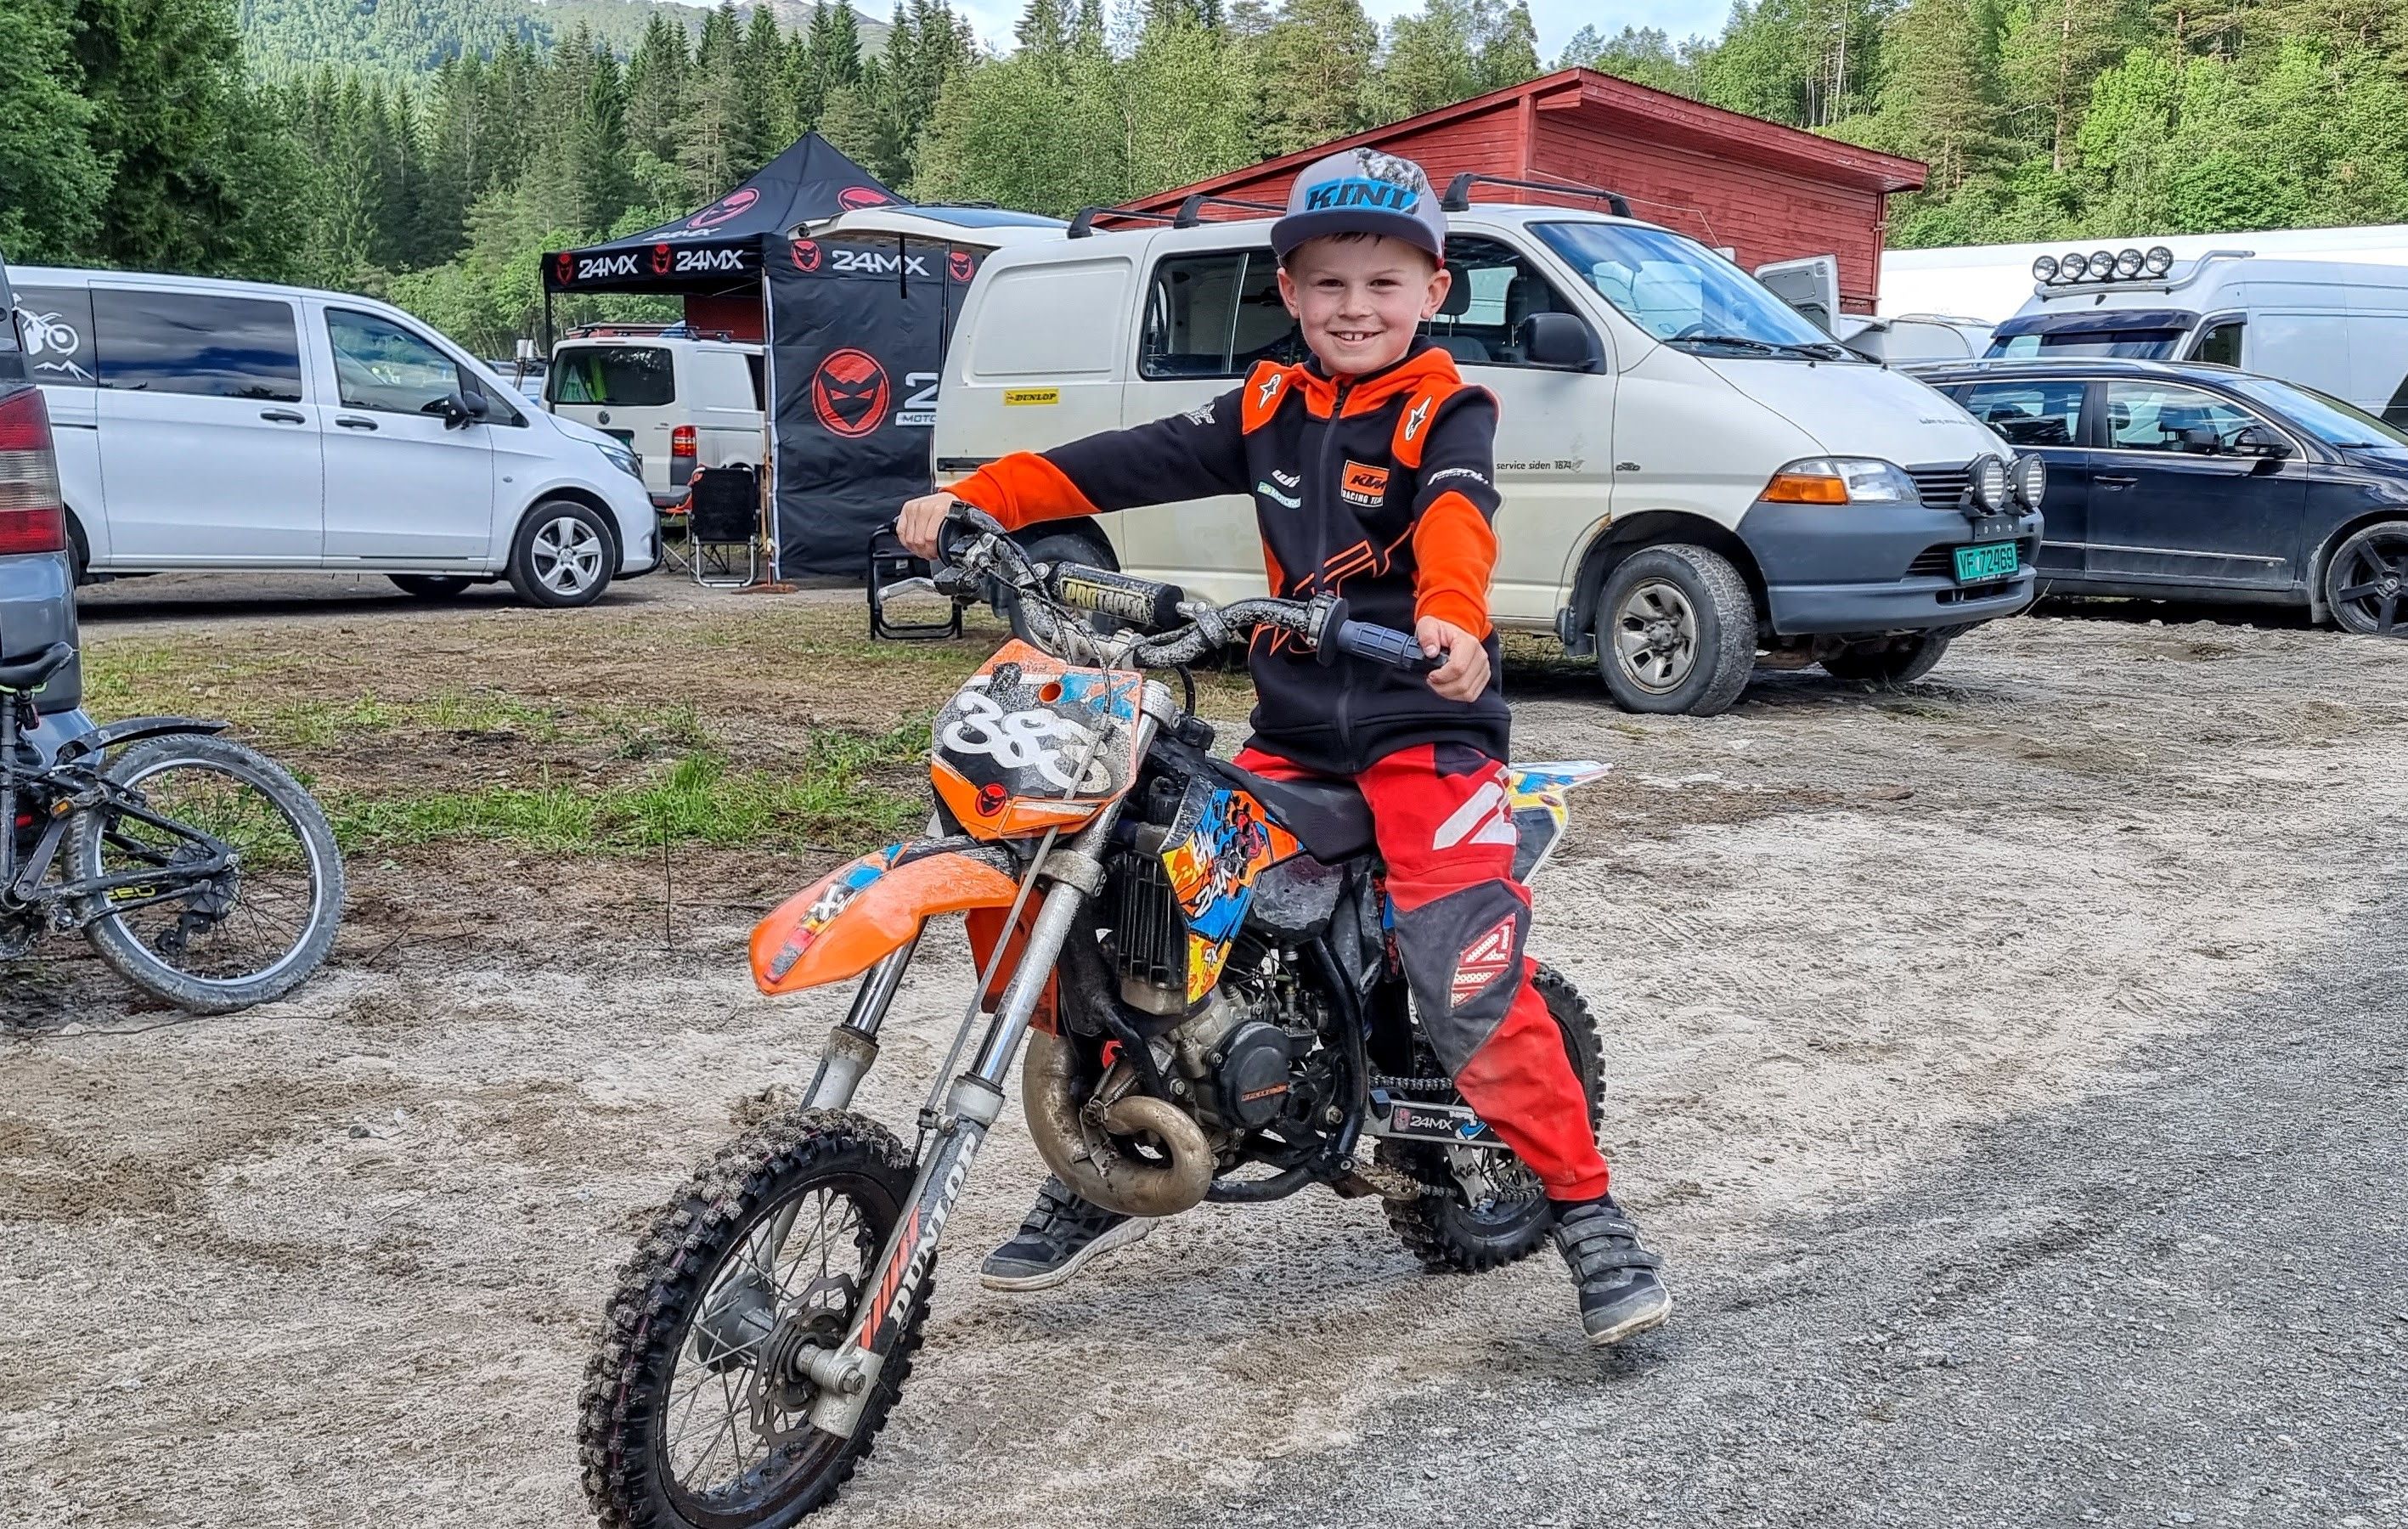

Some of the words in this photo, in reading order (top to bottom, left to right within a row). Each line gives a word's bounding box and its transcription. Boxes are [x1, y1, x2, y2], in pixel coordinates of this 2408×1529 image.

[1307, 183, 1407, 211] KINI
[578, 254, 638, 279] 24MX
[675, 250, 743, 271] 24MX
[832, 250, 930, 277] 24MX
[1496, 460, 1526, 470] service
[1529, 460, 1551, 470] siden
[1350, 473, 1387, 490] KTM
[1342, 490, 1368, 504] RACING
[1960, 552, 1974, 578] VF
[1979, 547, 2014, 574] 72469
[1410, 1114, 1453, 1131] 24MX
[888, 1131, 977, 1329] DUNLOP
